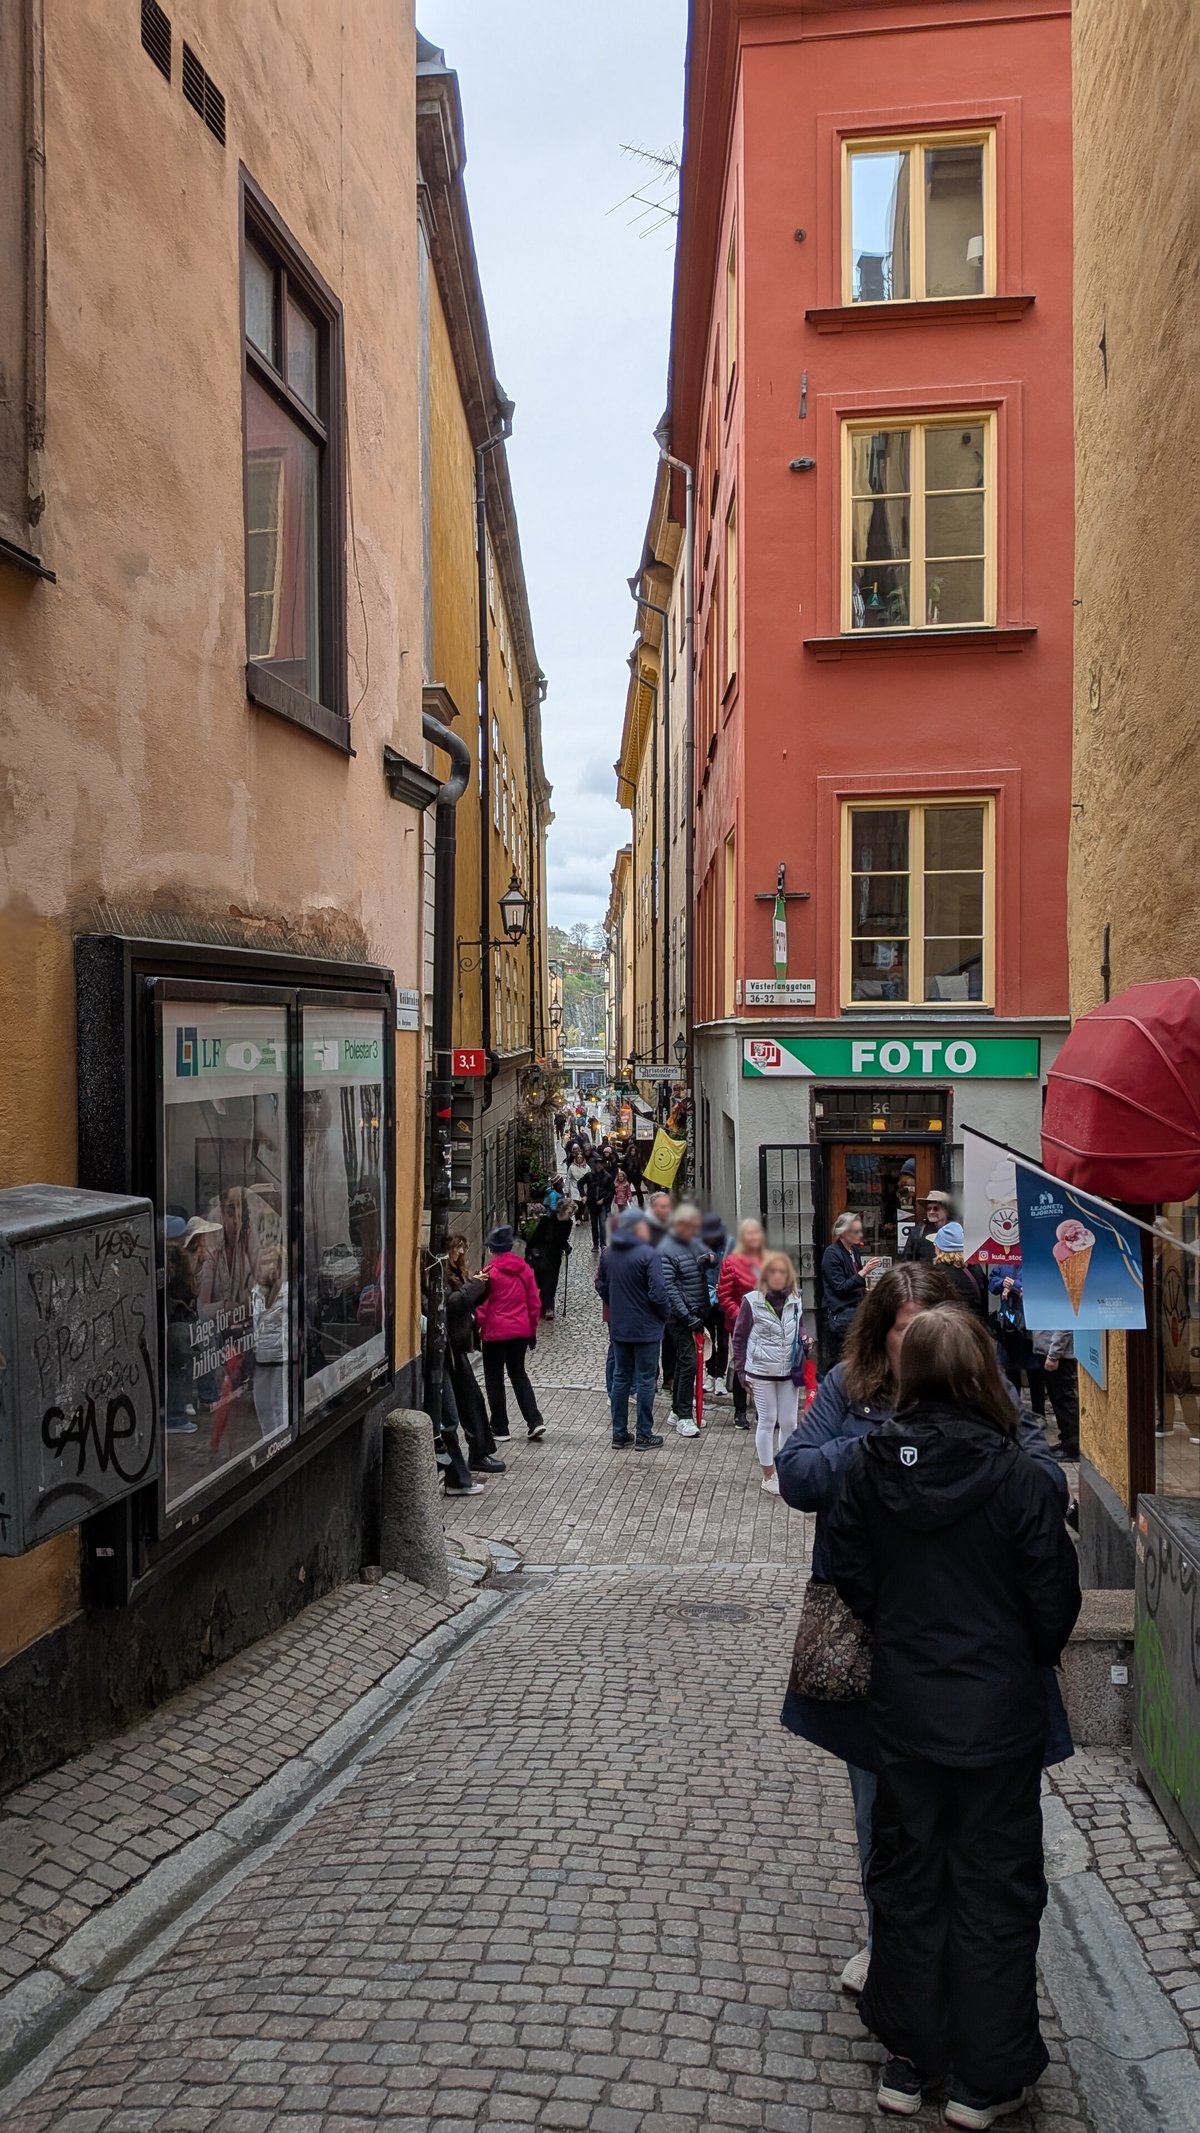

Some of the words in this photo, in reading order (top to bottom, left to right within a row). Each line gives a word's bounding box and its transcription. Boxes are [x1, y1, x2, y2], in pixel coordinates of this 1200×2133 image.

[750, 994, 776, 1003] 36-32
[201, 1038, 222, 1068] LF
[851, 1041, 977, 1073] FOTO
[871, 1102, 890, 1115] 36
[188, 1318, 215, 1349] Läge
[216, 1307, 231, 1334] för
[232, 1304, 246, 1324] en
